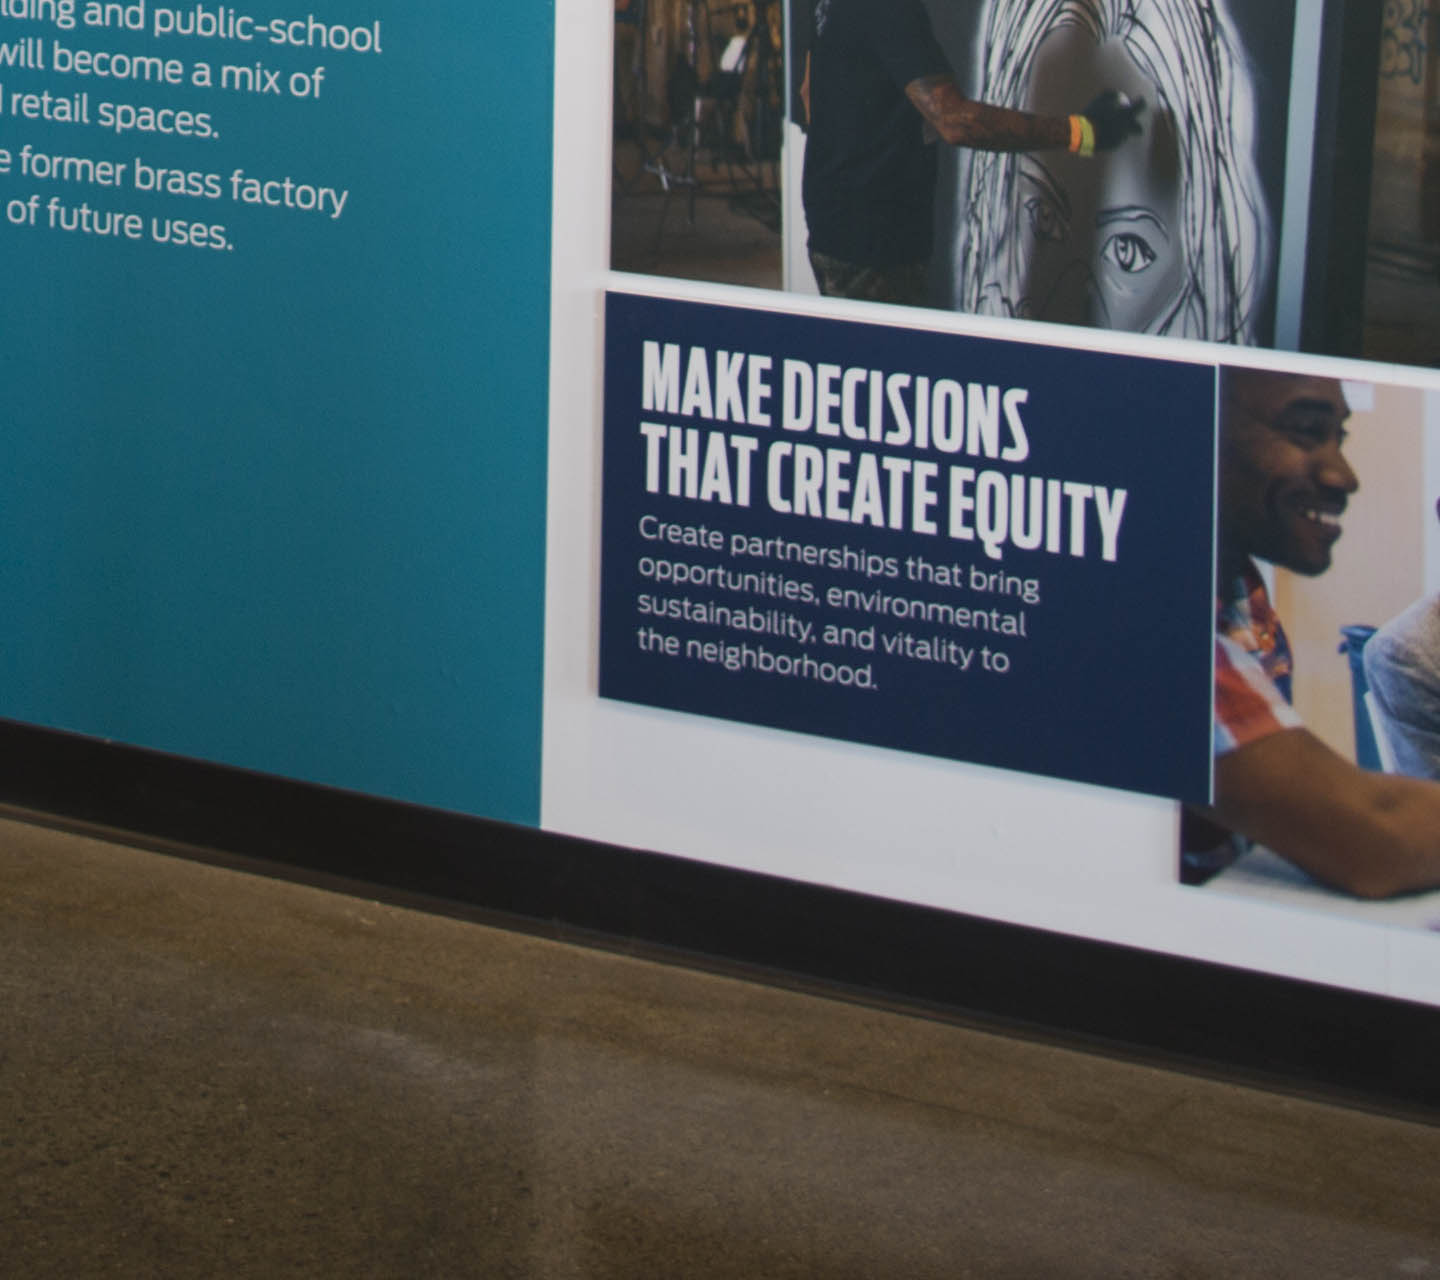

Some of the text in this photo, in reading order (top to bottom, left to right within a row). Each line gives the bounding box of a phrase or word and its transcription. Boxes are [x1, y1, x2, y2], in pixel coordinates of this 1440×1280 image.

[642, 340, 1030, 463] MAKE DECISIONS
[640, 421, 1128, 562] THAT CREATE EQUITY
[639, 514, 1040, 604] Create partnerships that bring
